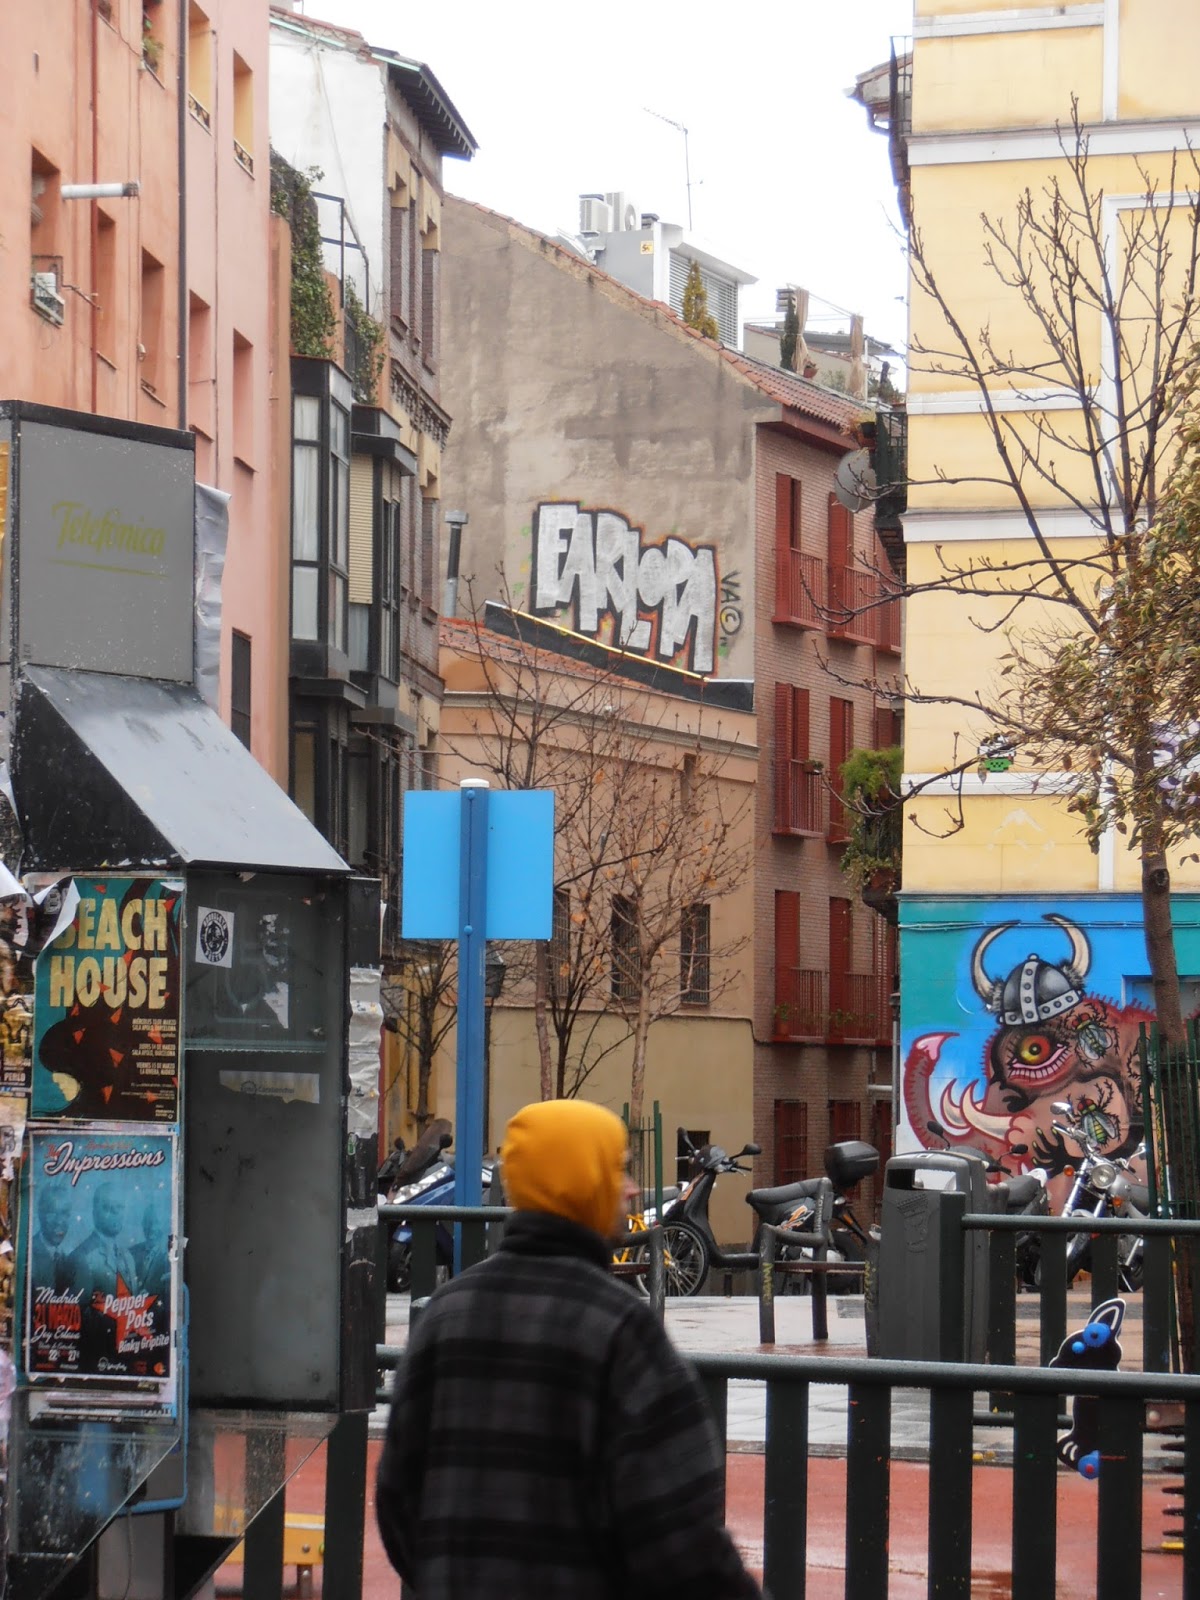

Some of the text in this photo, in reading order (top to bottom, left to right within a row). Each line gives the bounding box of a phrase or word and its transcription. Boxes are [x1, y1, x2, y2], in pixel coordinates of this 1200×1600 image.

[52, 501, 166, 555] Telefónica
[50, 956, 169, 1010] HOUSE
[44, 1141, 165, 1187] Impressions
[35, 1286, 85, 1304] Madrid
[104, 1292, 150, 1318] Pepper
[125, 1309, 155, 1330] Pots
[118, 1339, 141, 1354] Binky
